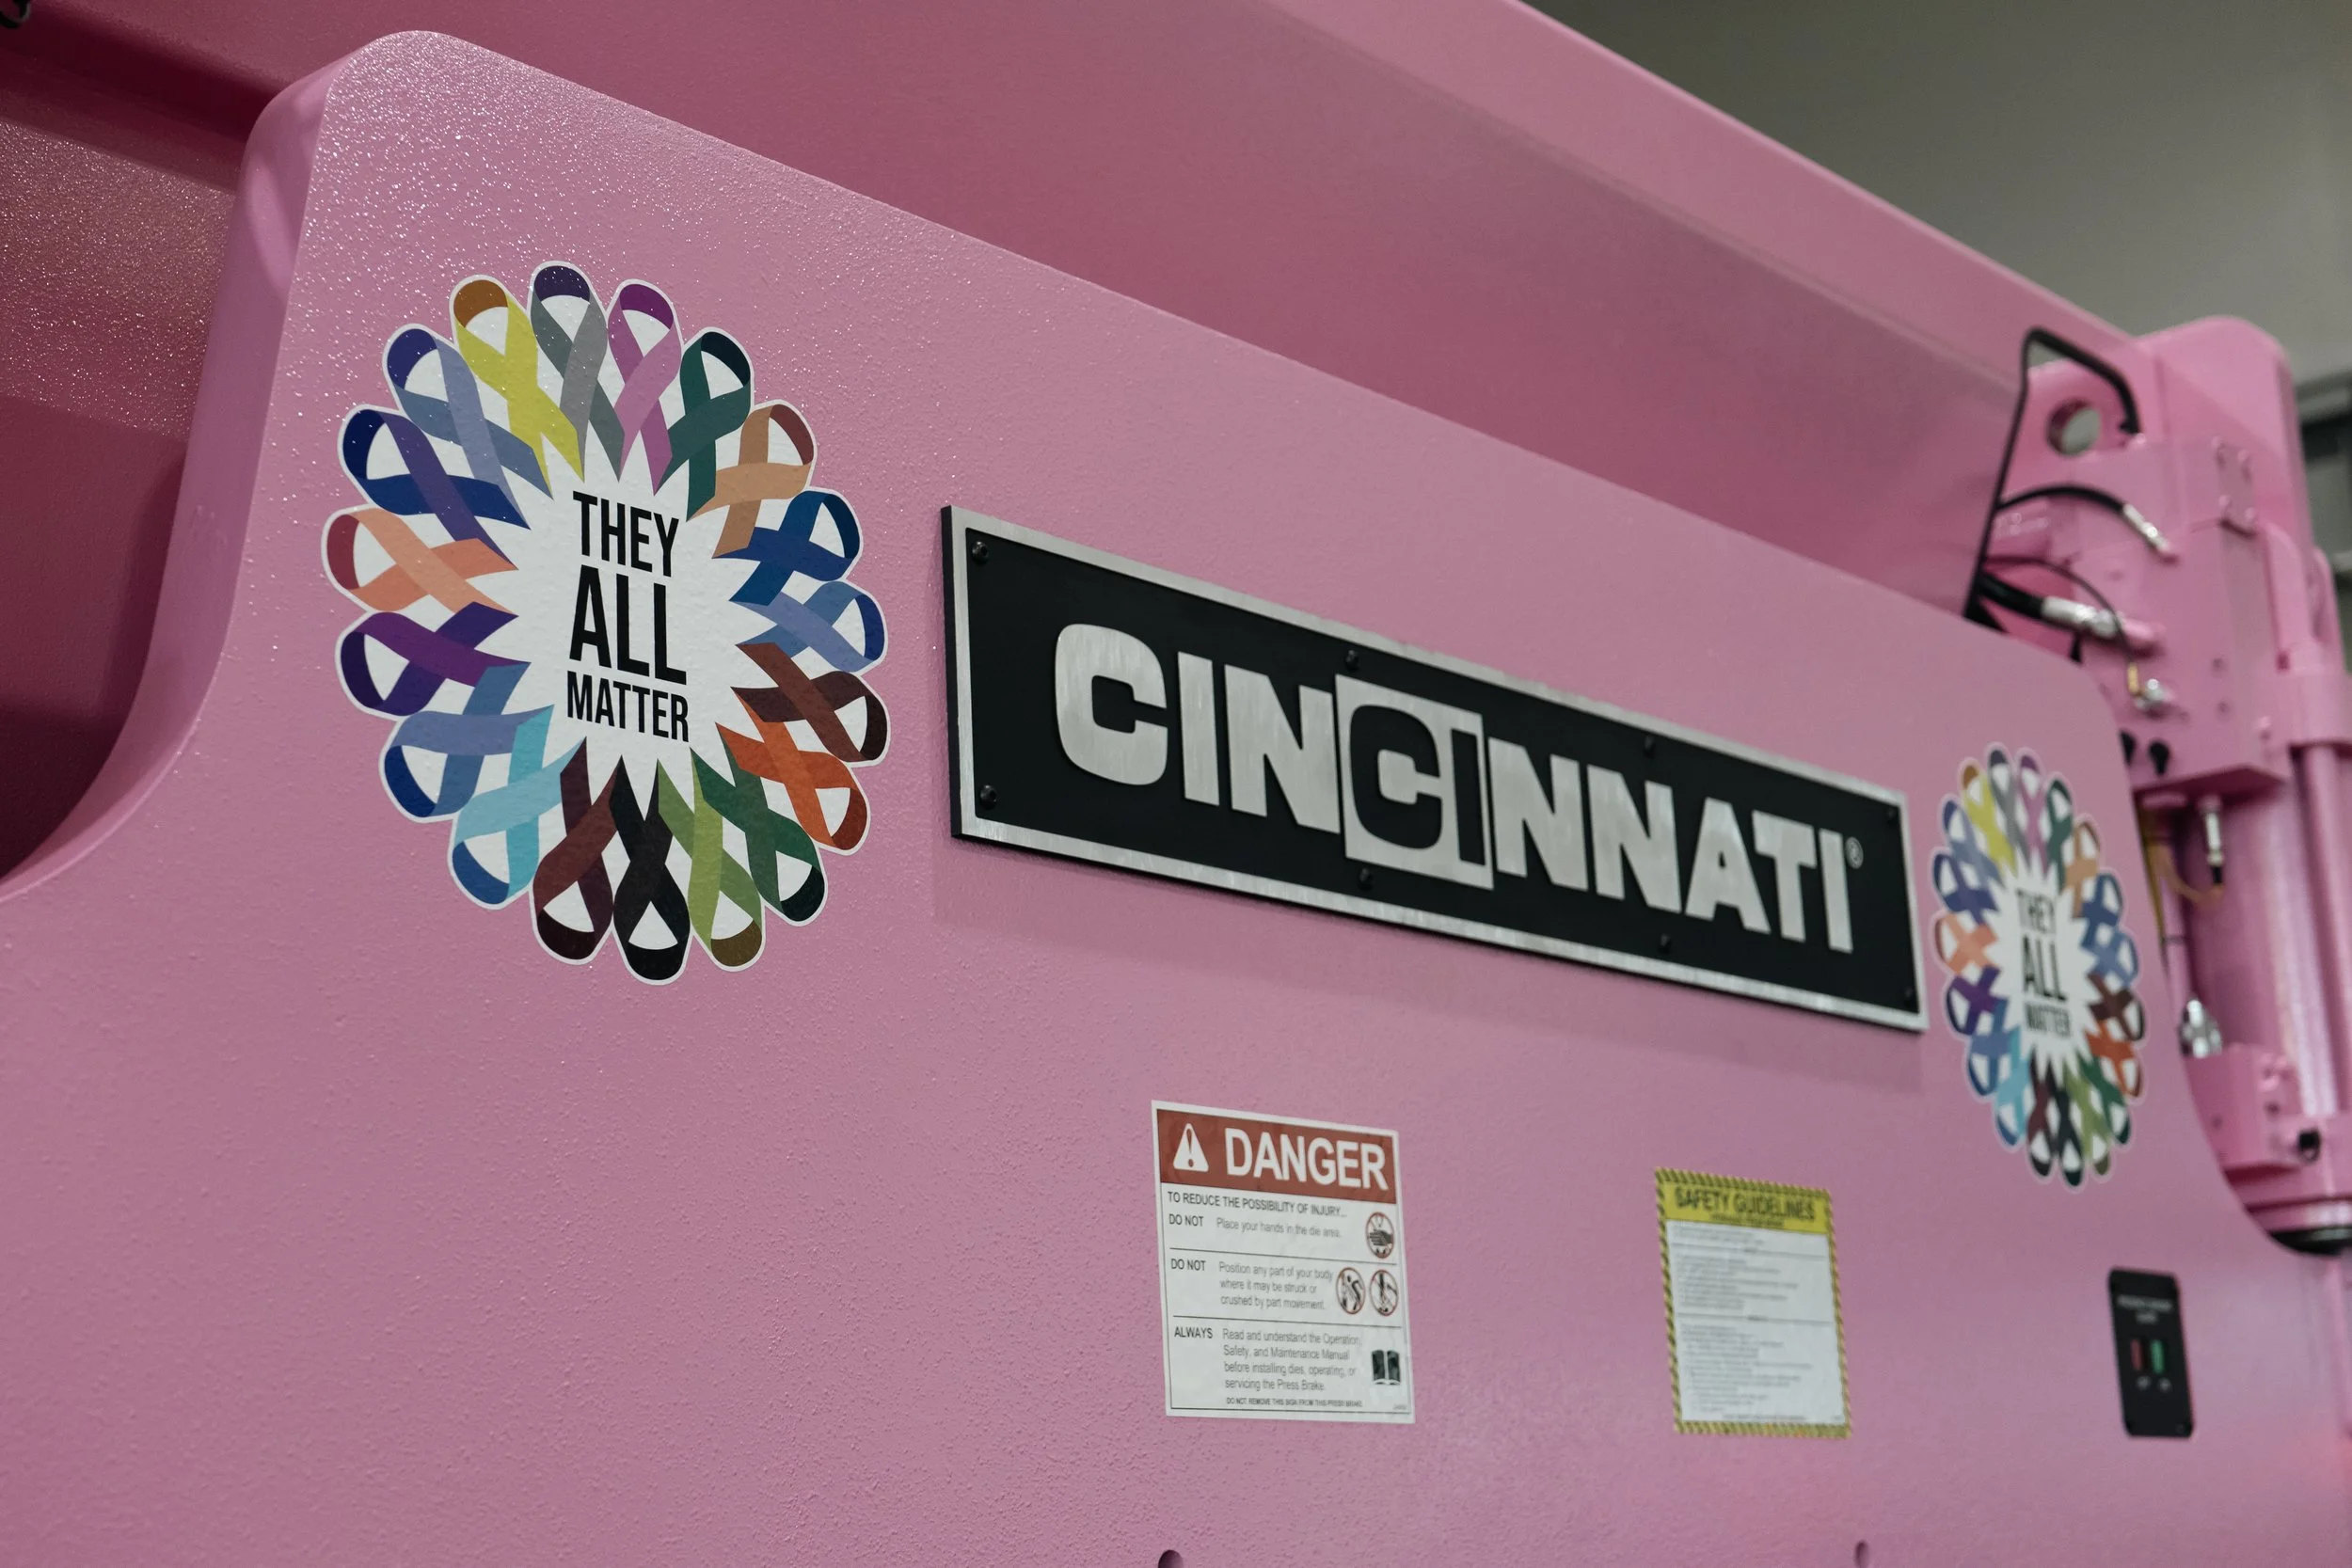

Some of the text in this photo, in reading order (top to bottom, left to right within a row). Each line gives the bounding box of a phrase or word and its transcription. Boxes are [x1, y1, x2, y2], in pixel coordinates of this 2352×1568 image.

[573, 490, 679, 578] THEY
[569, 564, 687, 686] ALL
[567, 670, 689, 743] MATTER
[2016, 888, 2057, 934] THEY
[2023, 934, 2067, 1002] ALL
[1225, 1128, 1389, 1191] DANGER
[1168, 1191, 1181, 1203] TO
[1183, 1193, 1220, 1207] REDUCE
[1222, 1196, 1240, 1209] THE
[1242, 1198, 1295, 1212] POSSIBILITY
[1296, 1203, 1309, 1214] OF
[1674, 1186, 1729, 1212] SAFETY
[1733, 1194, 1816, 1221] GUIDELINES
[1168, 1213, 1341, 1238] DO NOT Place your hands in the die area.
[1170, 1259, 1333, 1282] DO NOT Position any part of your body
[1219, 1278, 1318, 1294] where it may be struck or
[1220, 1295, 1326, 1310] crushed by part movement.
[1174, 1326, 1214, 1339] ALWAYS
[1222, 1328, 1245, 1340] Read
[1247, 1329, 1262, 1341] and
[1263, 1330, 1307, 1343] understand
[1309, 1332, 1321, 1344] the
[1224, 1344, 1350, 1360] Safety, and Maintenance Manual
[1224, 1361, 1249, 1372] before
[1252, 1363, 1286, 1376] installing
[1348, 1368, 1357, 1377] or
[1225, 1378, 1261, 1392] servicing
[1263, 1378, 1275, 1389] the
[1277, 1379, 1299, 1390] Press
